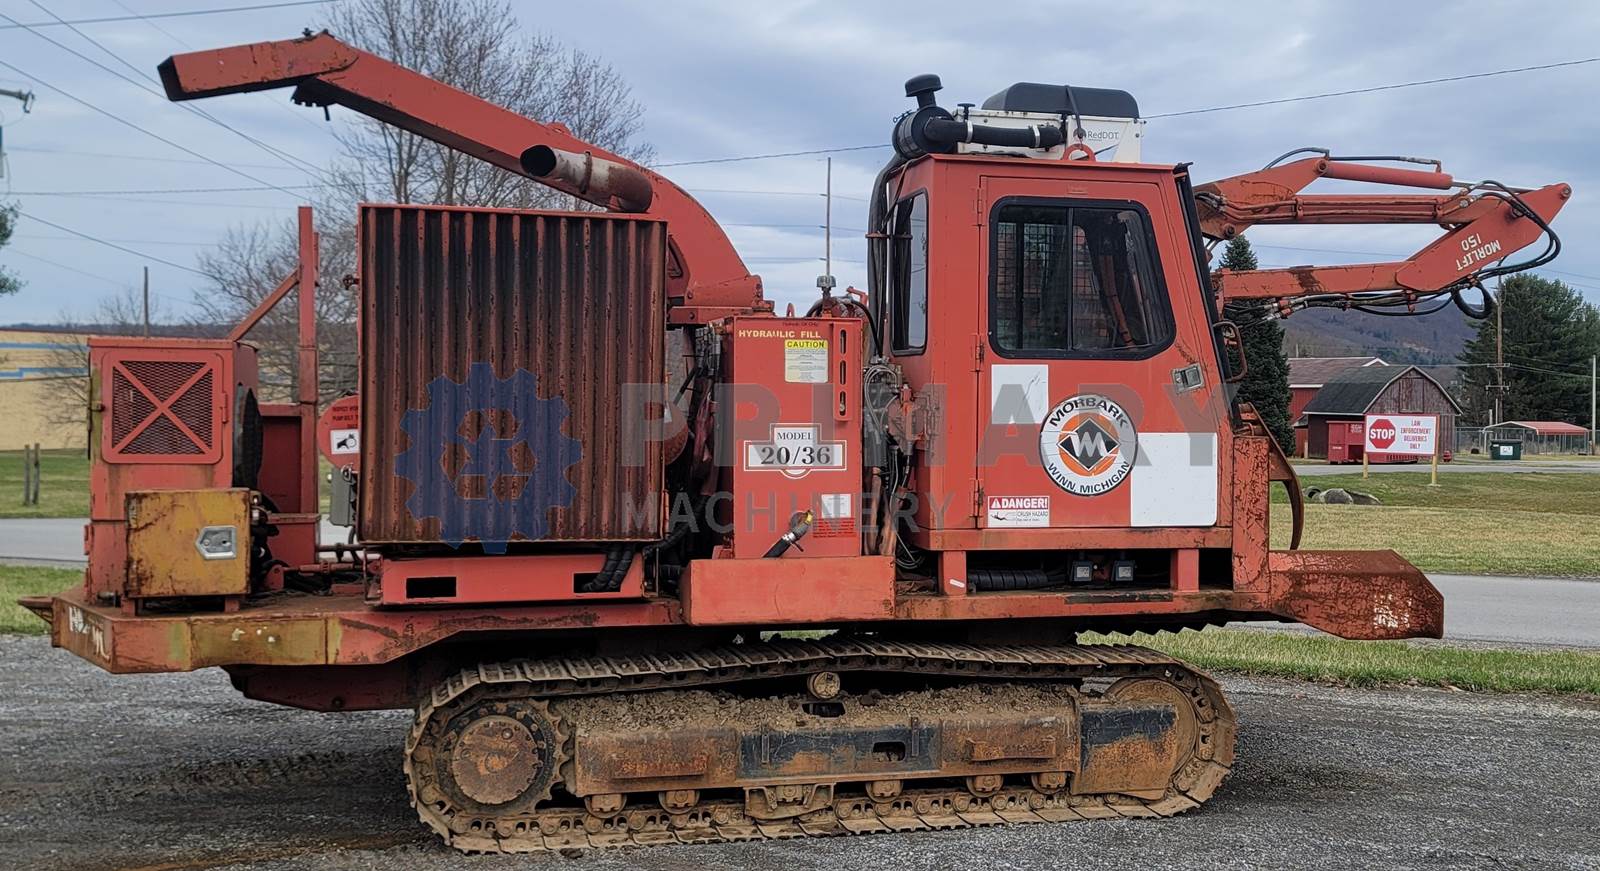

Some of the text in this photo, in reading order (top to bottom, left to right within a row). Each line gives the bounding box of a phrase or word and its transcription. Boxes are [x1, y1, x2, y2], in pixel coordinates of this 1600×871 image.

[1087, 130, 1119, 139] RedDOT
[1461, 233, 1482, 251] 150
[1456, 239, 1502, 271] MORLIFT
[738, 329, 821, 338] HYDRAULIC FILL
[1049, 397, 1128, 427] MORBARK
[777, 432, 812, 440] MODEL
[1370, 428, 1395, 440] STOP
[761, 446, 831, 464] 20/36
[1048, 461, 1130, 493] WINN, MICHIGAN
[1001, 498, 1048, 509] DANGER!
